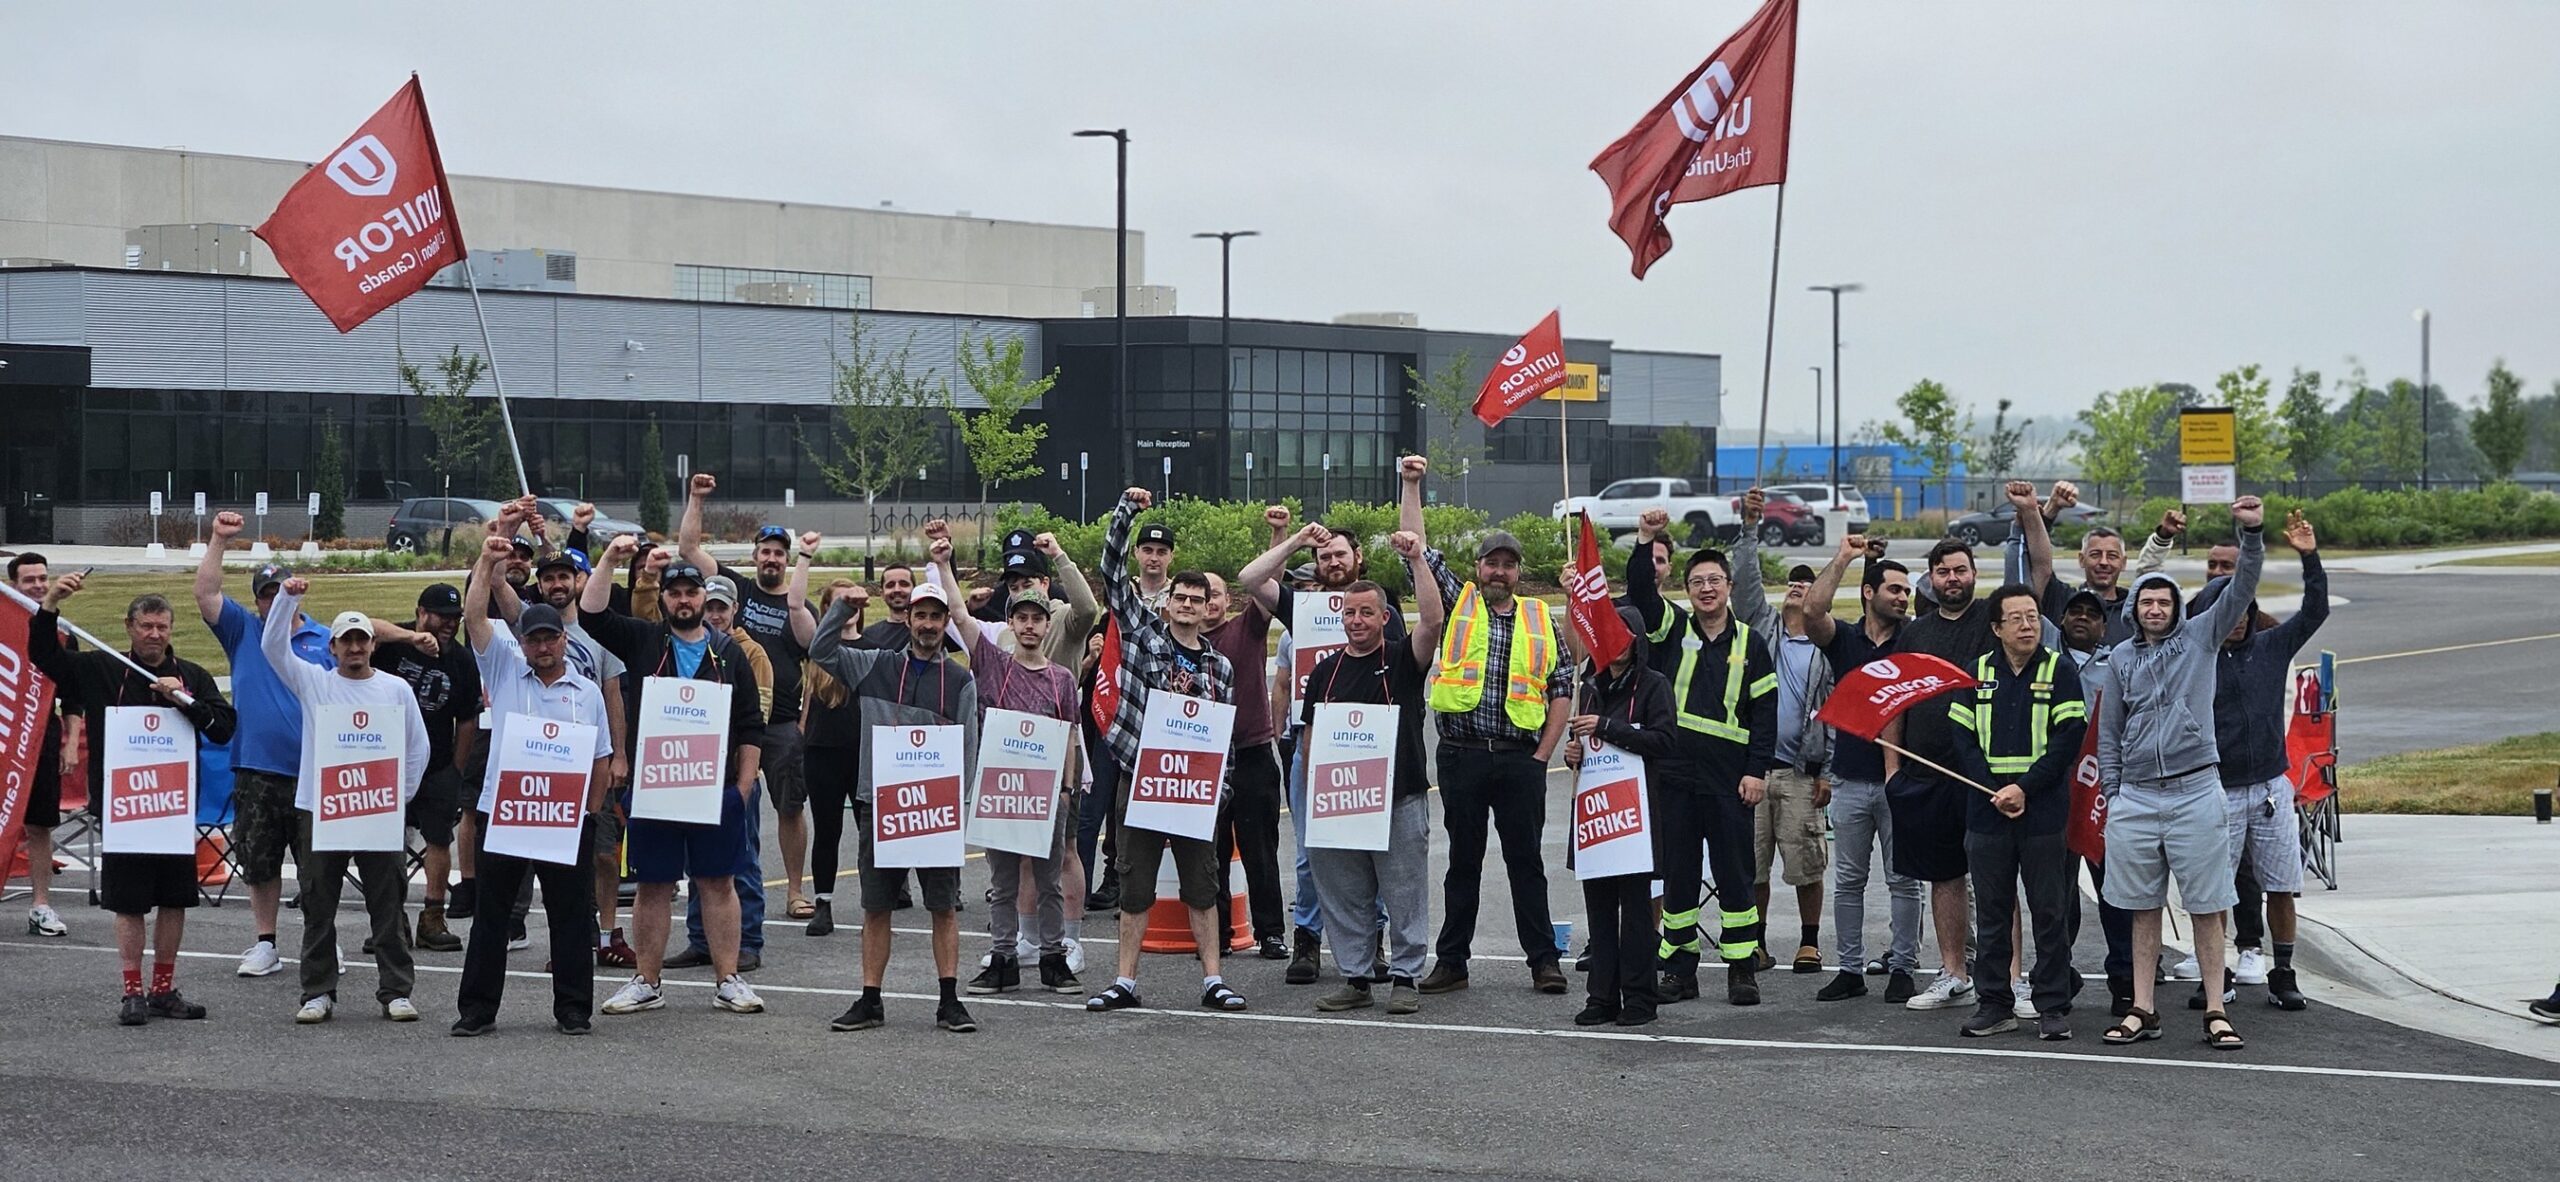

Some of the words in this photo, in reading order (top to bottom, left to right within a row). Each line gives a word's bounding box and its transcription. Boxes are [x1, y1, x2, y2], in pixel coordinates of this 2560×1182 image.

[1137, 440, 1154, 448] Main
[1155, 440, 1190, 449] Reception
[746, 598, 789, 619] UNDER
[1314, 616, 1343, 625] UNIF
[661, 739, 689, 760] ON
[644, 761, 715, 784] STRIKE
[1160, 753, 1189, 774] ON
[129, 769, 159, 791] ON
[338, 767, 368, 789] ON
[520, 775, 550, 797] ON
[997, 772, 1024, 792] ON
[1140, 776, 1213, 800] STRIKE
[1331, 766, 1358, 788] ON
[113, 790, 186, 817] STRIKE
[323, 787, 395, 815] STRIKE
[897, 784, 928, 808] ON
[980, 794, 1047, 815] STRIKE
[1315, 787, 1383, 813] STRIKE
[1585, 790, 1610, 816] ON
[499, 799, 576, 823] STRIKE
[882, 805, 957, 835] STRIKE
[1578, 807, 1640, 844] STRIKE
